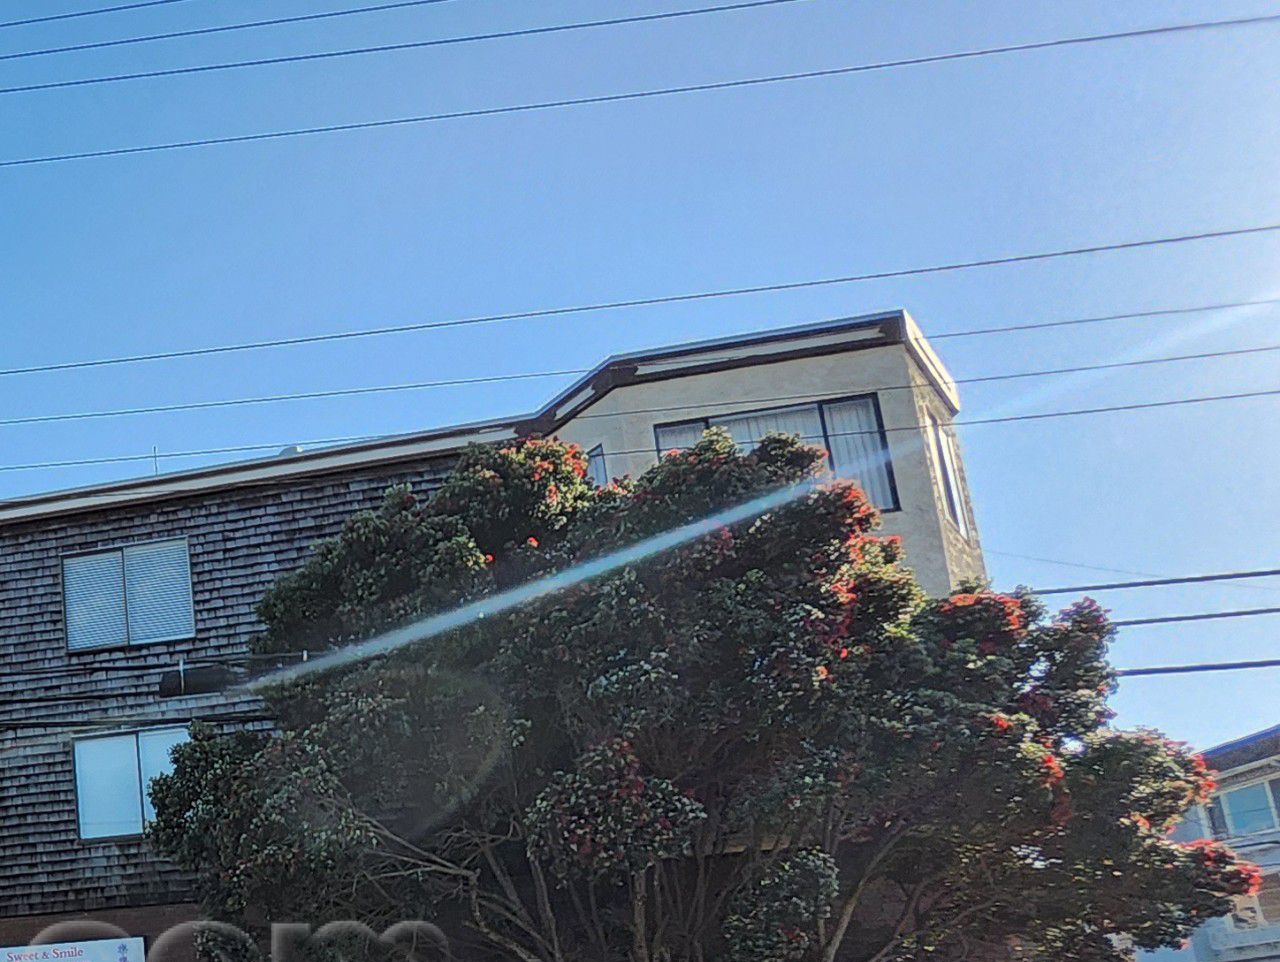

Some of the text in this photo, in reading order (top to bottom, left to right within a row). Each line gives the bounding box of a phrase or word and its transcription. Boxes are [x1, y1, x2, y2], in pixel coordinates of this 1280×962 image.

[6, 947, 84, 962] Sweet & Smile
